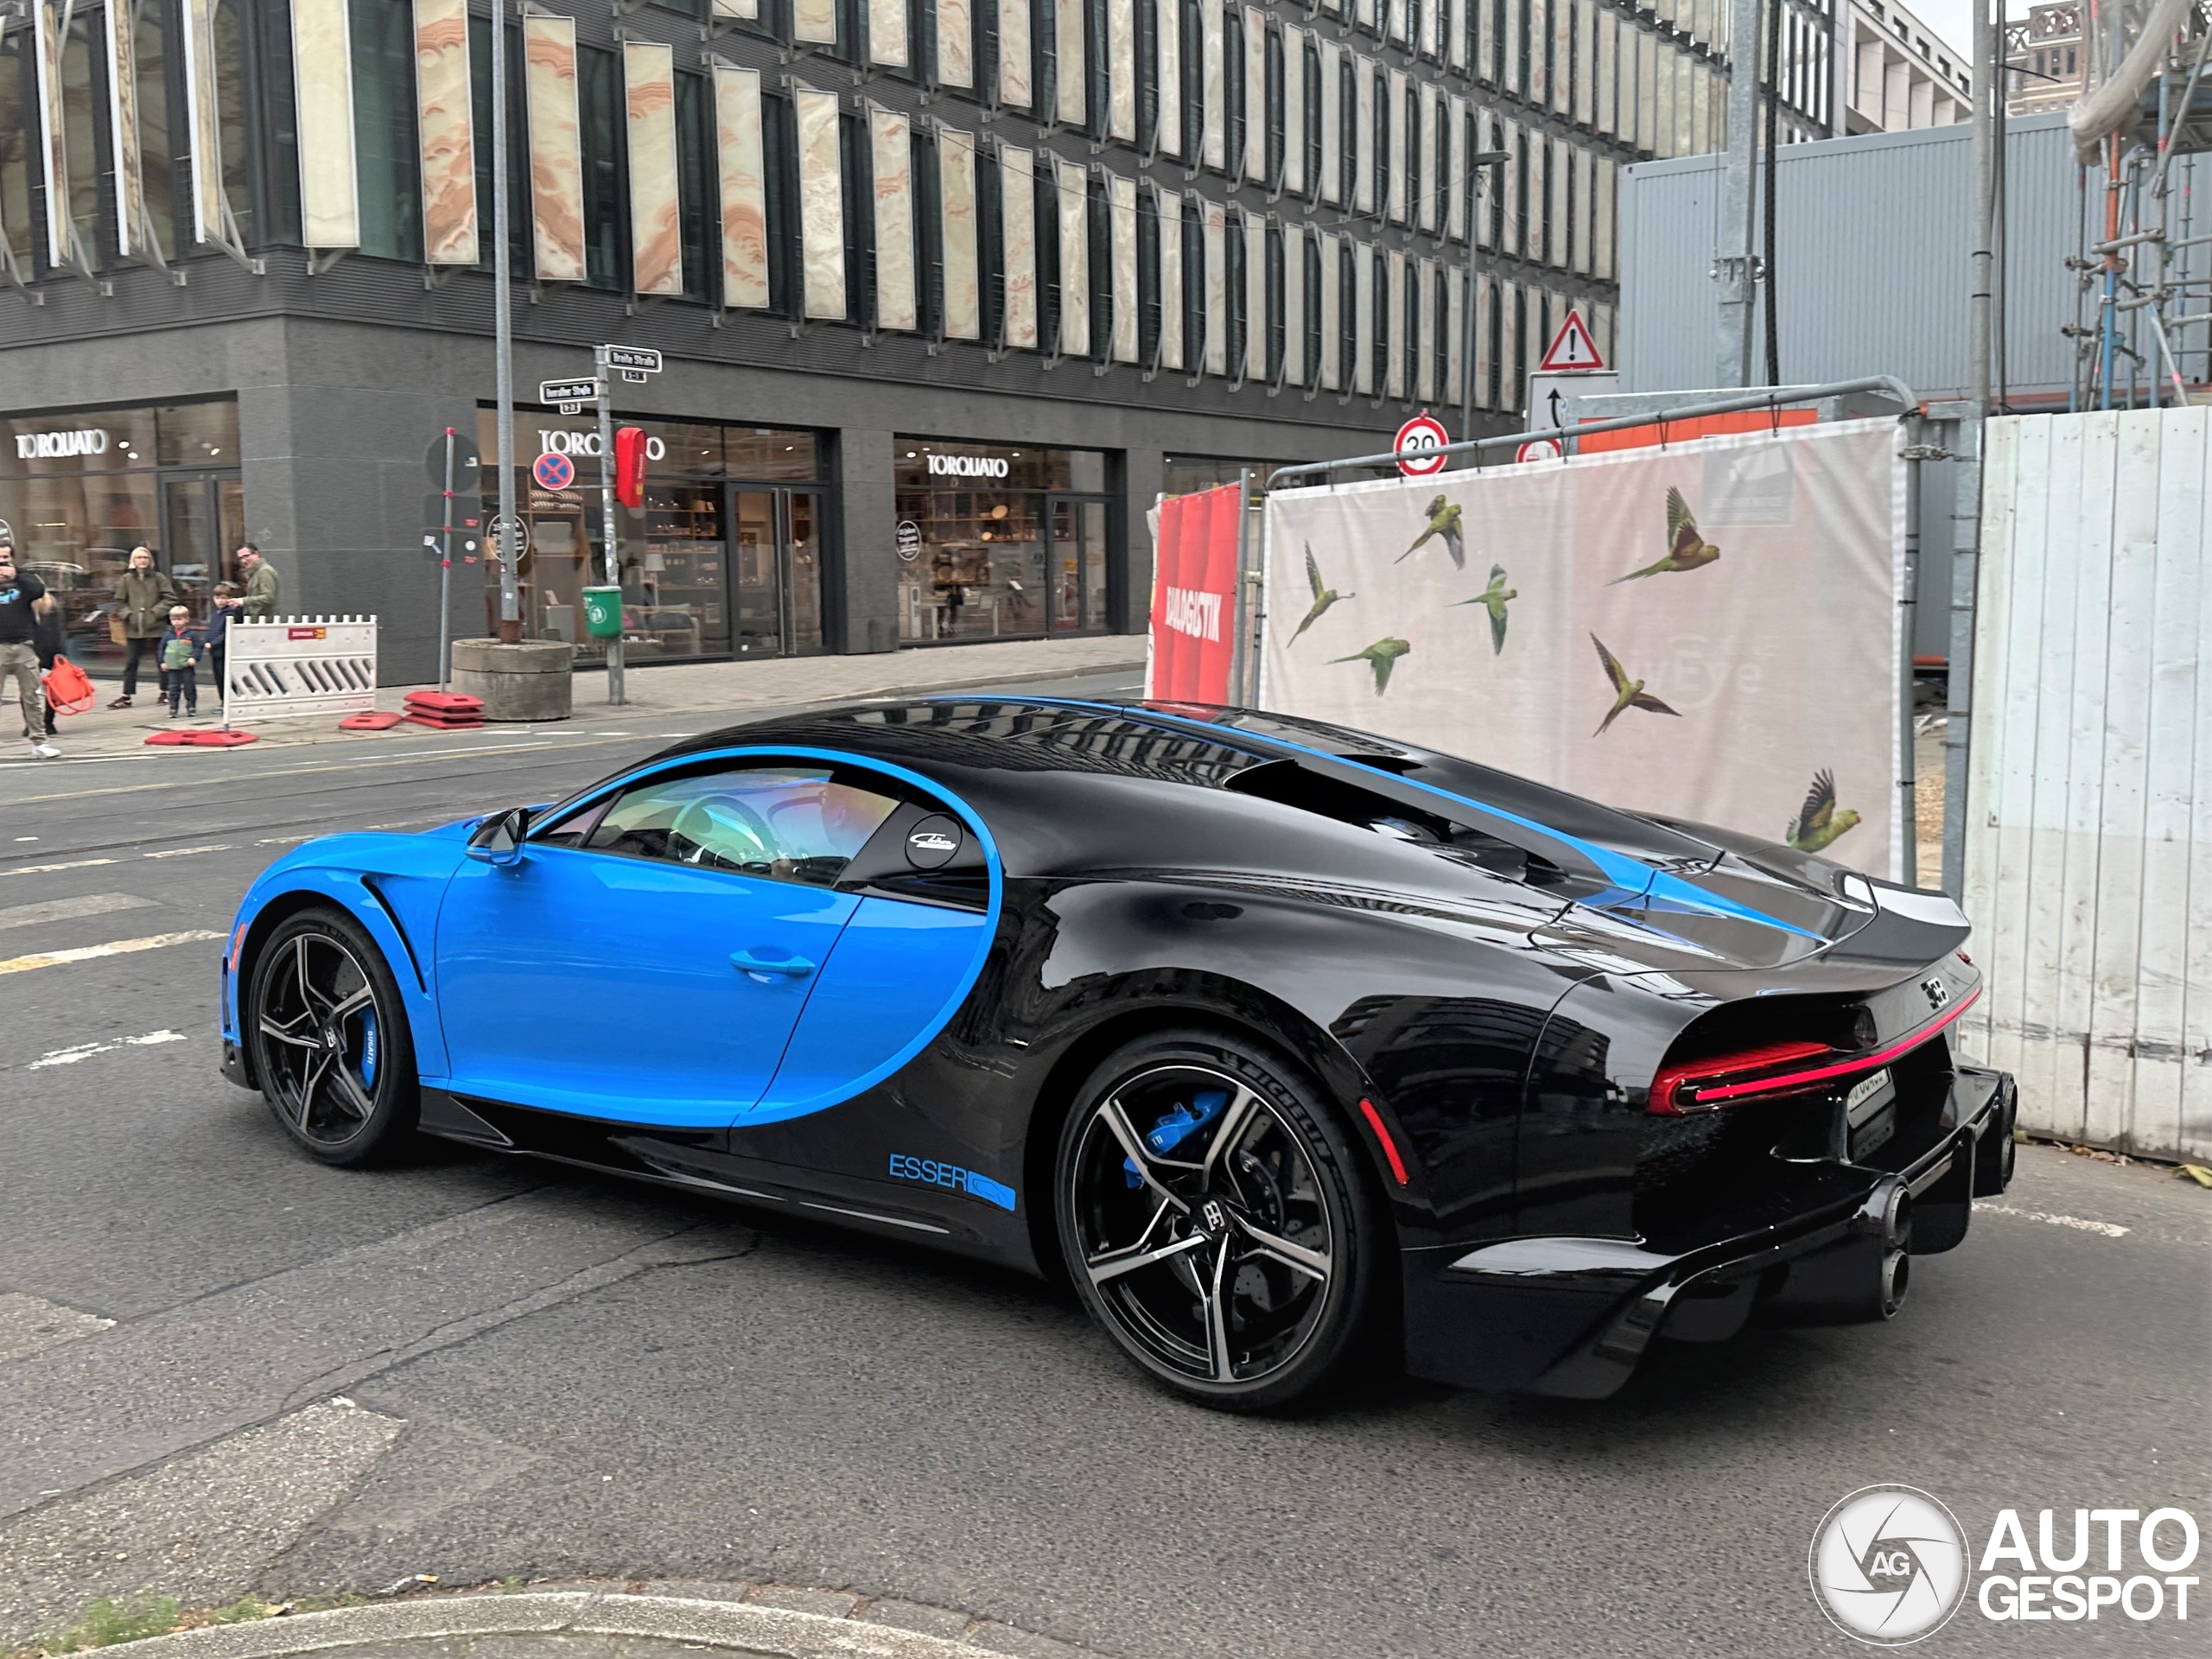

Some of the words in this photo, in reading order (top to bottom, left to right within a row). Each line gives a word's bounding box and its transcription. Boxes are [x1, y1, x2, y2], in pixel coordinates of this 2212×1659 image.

[15, 429, 107, 459] TORQUATO
[926, 454, 1009, 478] TORQUATO
[889, 1153, 967, 1192] ESSER
